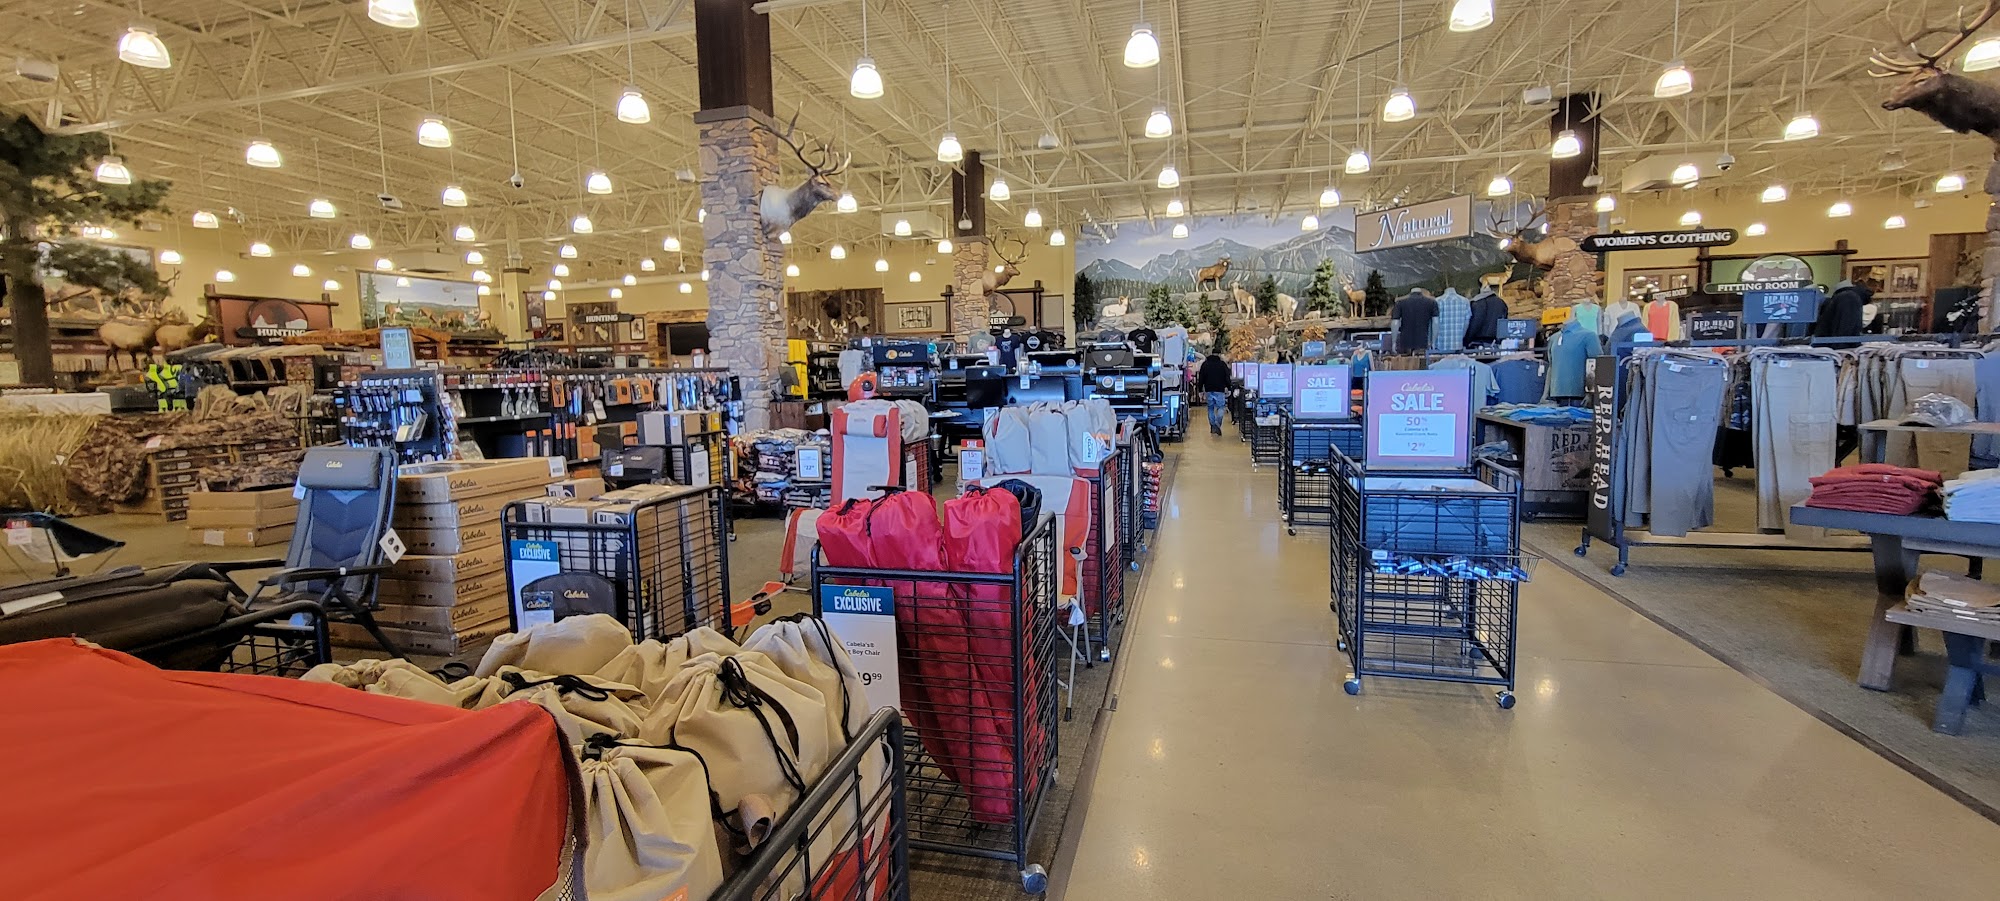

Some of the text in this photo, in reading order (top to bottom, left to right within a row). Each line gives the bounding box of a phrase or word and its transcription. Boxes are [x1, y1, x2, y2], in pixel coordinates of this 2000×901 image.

[1370, 207, 1453, 248] Natural
[1593, 232, 1731, 247] WOMEN'S CLOTHING
[1717, 281, 1799, 291] FITTING ROOM
[585, 314, 618, 323] HUNTING
[1267, 371, 1285, 379] SALE
[1307, 377, 1336, 388] SALE
[1391, 393, 1444, 411] SALE
[1550, 433, 1581, 451] RED
[1563, 443, 1590, 455] BRAN
[1590, 404, 1603, 486] BRAND CO.
[1593, 385, 1614, 510] RED HEAD
[520, 548, 551, 560] EXCLUSIVE
[834, 596, 882, 612] EXCLUSIVE
